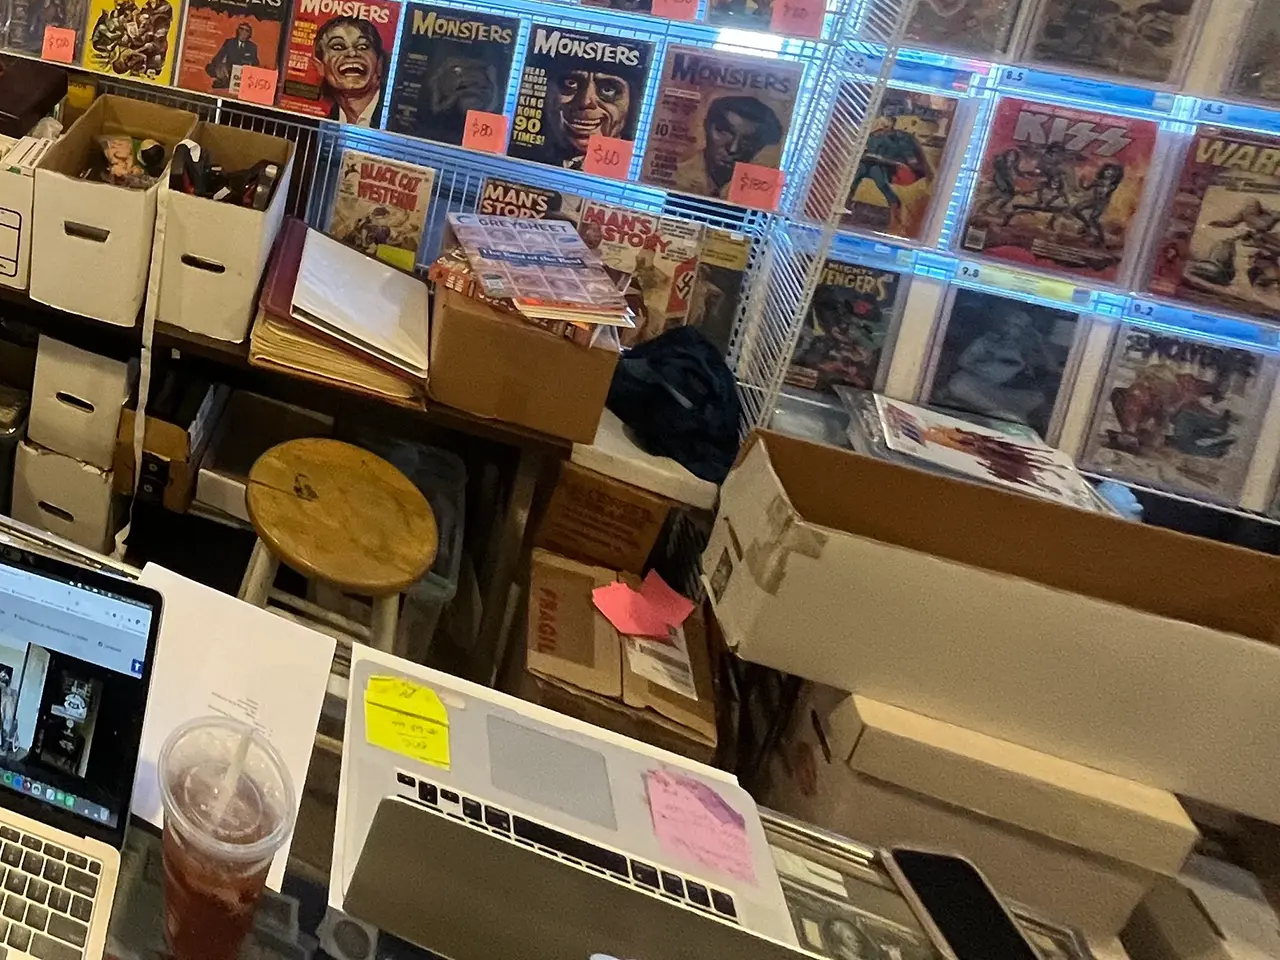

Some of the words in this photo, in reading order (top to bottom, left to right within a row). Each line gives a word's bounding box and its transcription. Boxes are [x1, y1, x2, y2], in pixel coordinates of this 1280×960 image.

[411, 9, 513, 45] MONSTERS
[533, 28, 641, 67] MONSTERS
[247, 74, 271, 92] $150
[523, 74, 548, 85] ABOUT
[671, 52, 791, 94] MONSTERS
[517, 105, 543, 119] KONG
[519, 95, 544, 109] KING
[472, 117, 493, 137] $80
[514, 115, 541, 133] 90
[655, 122, 670, 137] 10
[1013, 111, 1134, 157] KISS
[513, 129, 546, 146] TIMES!
[593, 145, 620, 167] $60
[360, 162, 400, 188] BLACK
[357, 180, 419, 212] WESTERN
[483, 183, 549, 212] MAN'S
[481, 200, 548, 220] STORY
[583, 206, 652, 234] MAN'S
[478, 217, 568, 234] GREYSHEET
[602, 228, 673, 254] STORY
[482, 248, 501, 258] The
[503, 251, 526, 261] Best
[527, 254, 539, 262] of
[540, 255, 557, 264] the
[558, 257, 582, 266] Best
[961, 265, 980, 278] 9.8
[819, 270, 888, 300] VENGERS
